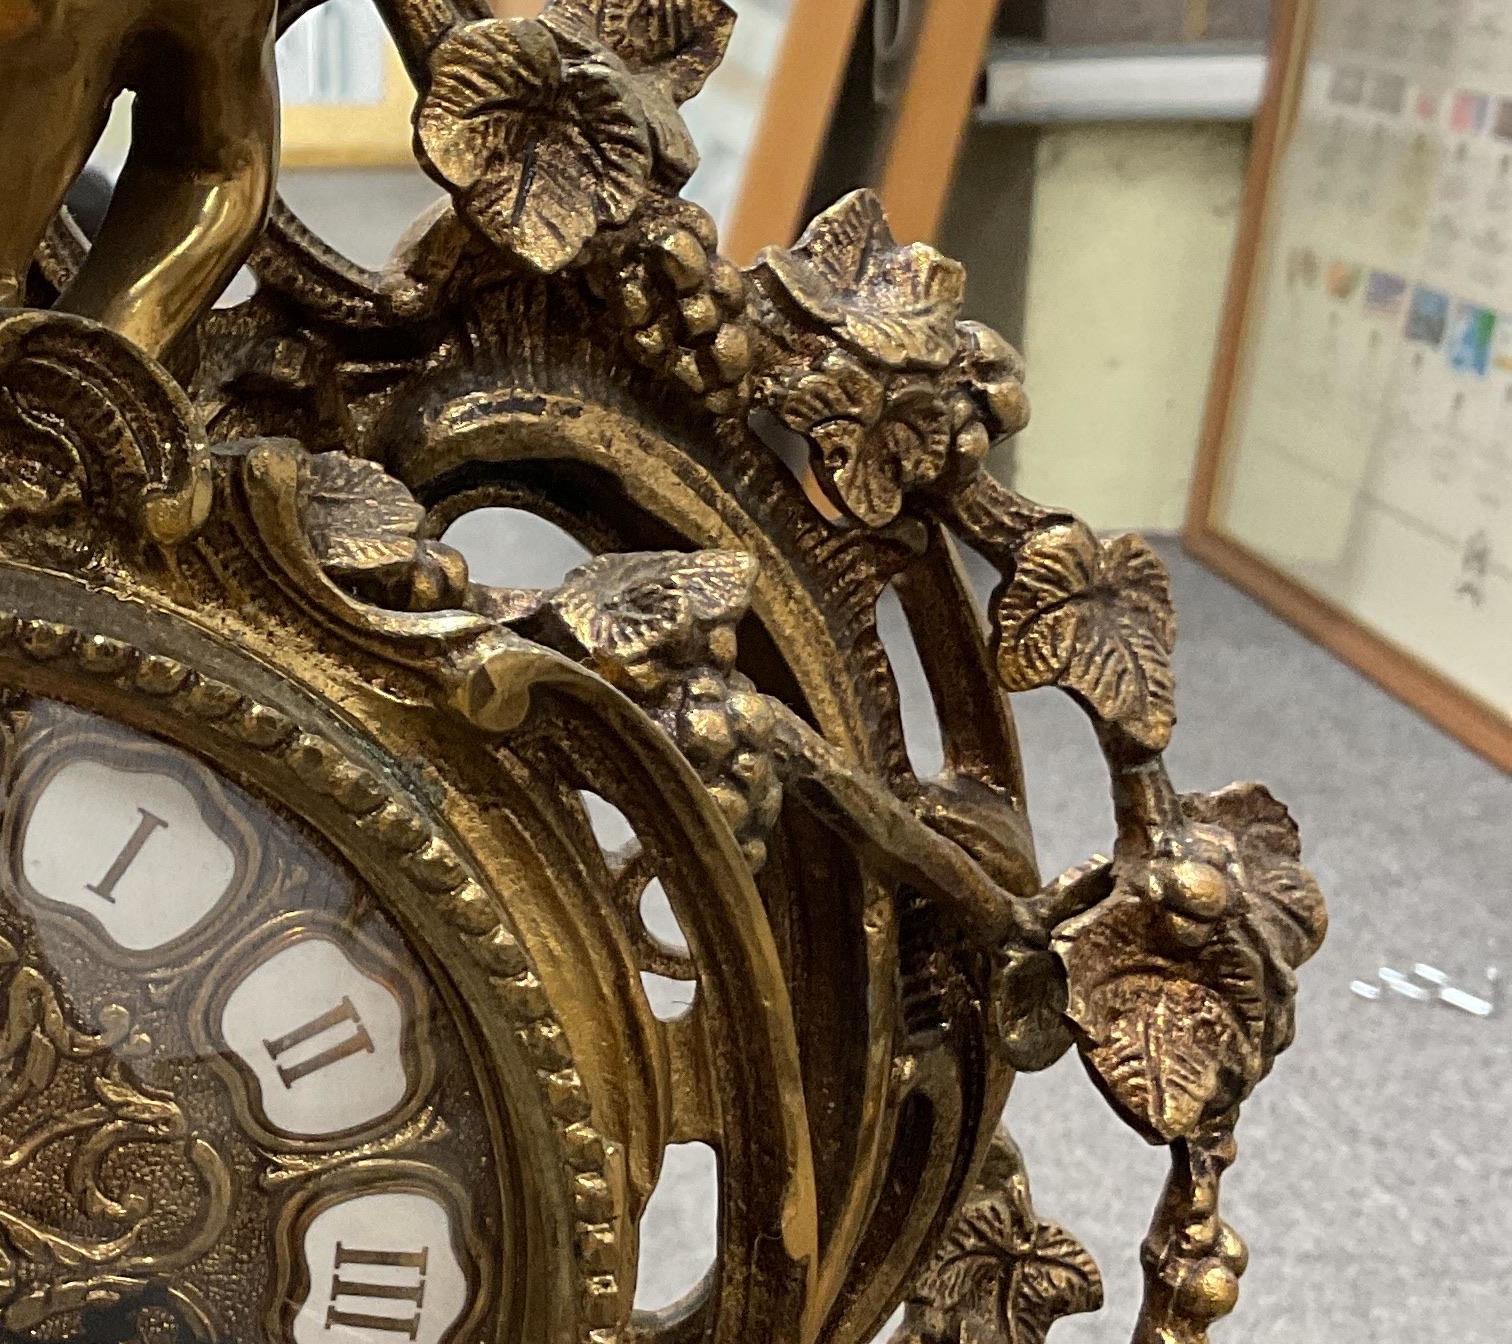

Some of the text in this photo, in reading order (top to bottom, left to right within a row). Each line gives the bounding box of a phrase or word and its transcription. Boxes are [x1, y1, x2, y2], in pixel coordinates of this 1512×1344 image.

[86, 807, 169, 904] I
[263, 996, 375, 1089] II
[325, 1241, 428, 1342] III
